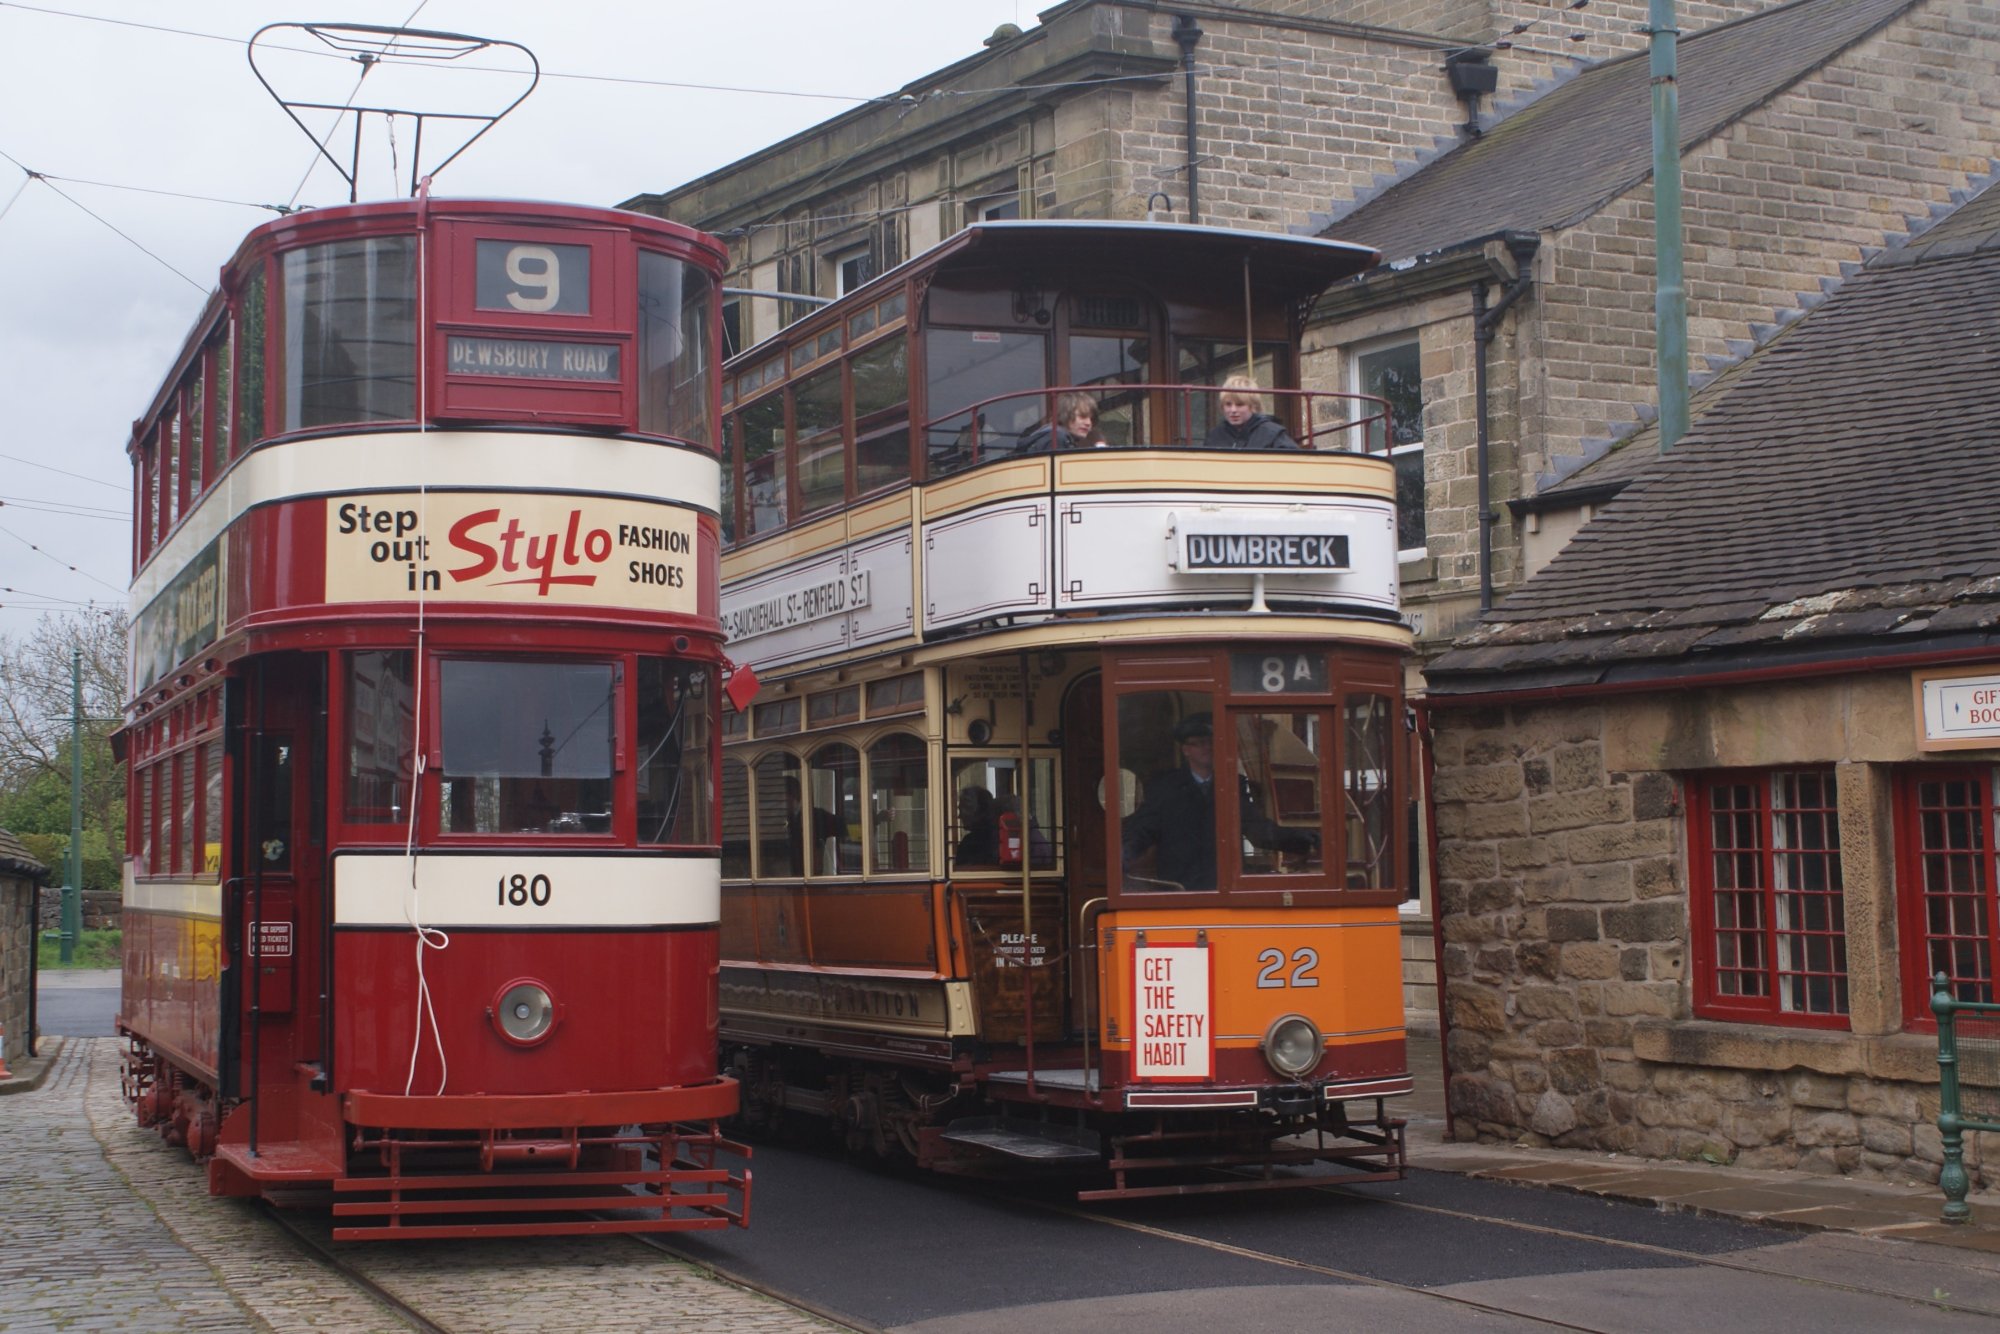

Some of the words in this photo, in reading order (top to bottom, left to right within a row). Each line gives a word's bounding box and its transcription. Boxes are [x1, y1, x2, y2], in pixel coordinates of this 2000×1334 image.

[506, 246, 560, 312] 9
[453, 340, 549, 369] DEWSBURY
[563, 346, 608, 373] ROAD
[339, 503, 418, 538] Step
[370, 535, 430, 563] out
[447, 508, 613, 596] Stylo
[618, 524, 690, 555] FASHION
[1188, 535, 1336, 566] DUMBRECK
[408, 563, 441, 591] in
[628, 561, 684, 589] SHOES
[1973, 689, 2000, 705] GIF
[498, 873, 552, 907] 180
[1001, 933, 1038, 944] PLEAE
[1144, 958, 1174, 982] GET
[1256, 946, 1320, 990] 22
[1144, 986, 1176, 1010] THE
[1144, 1014, 1205, 1038] SAFETY
[1144, 1042, 1188, 1067] HABIT
